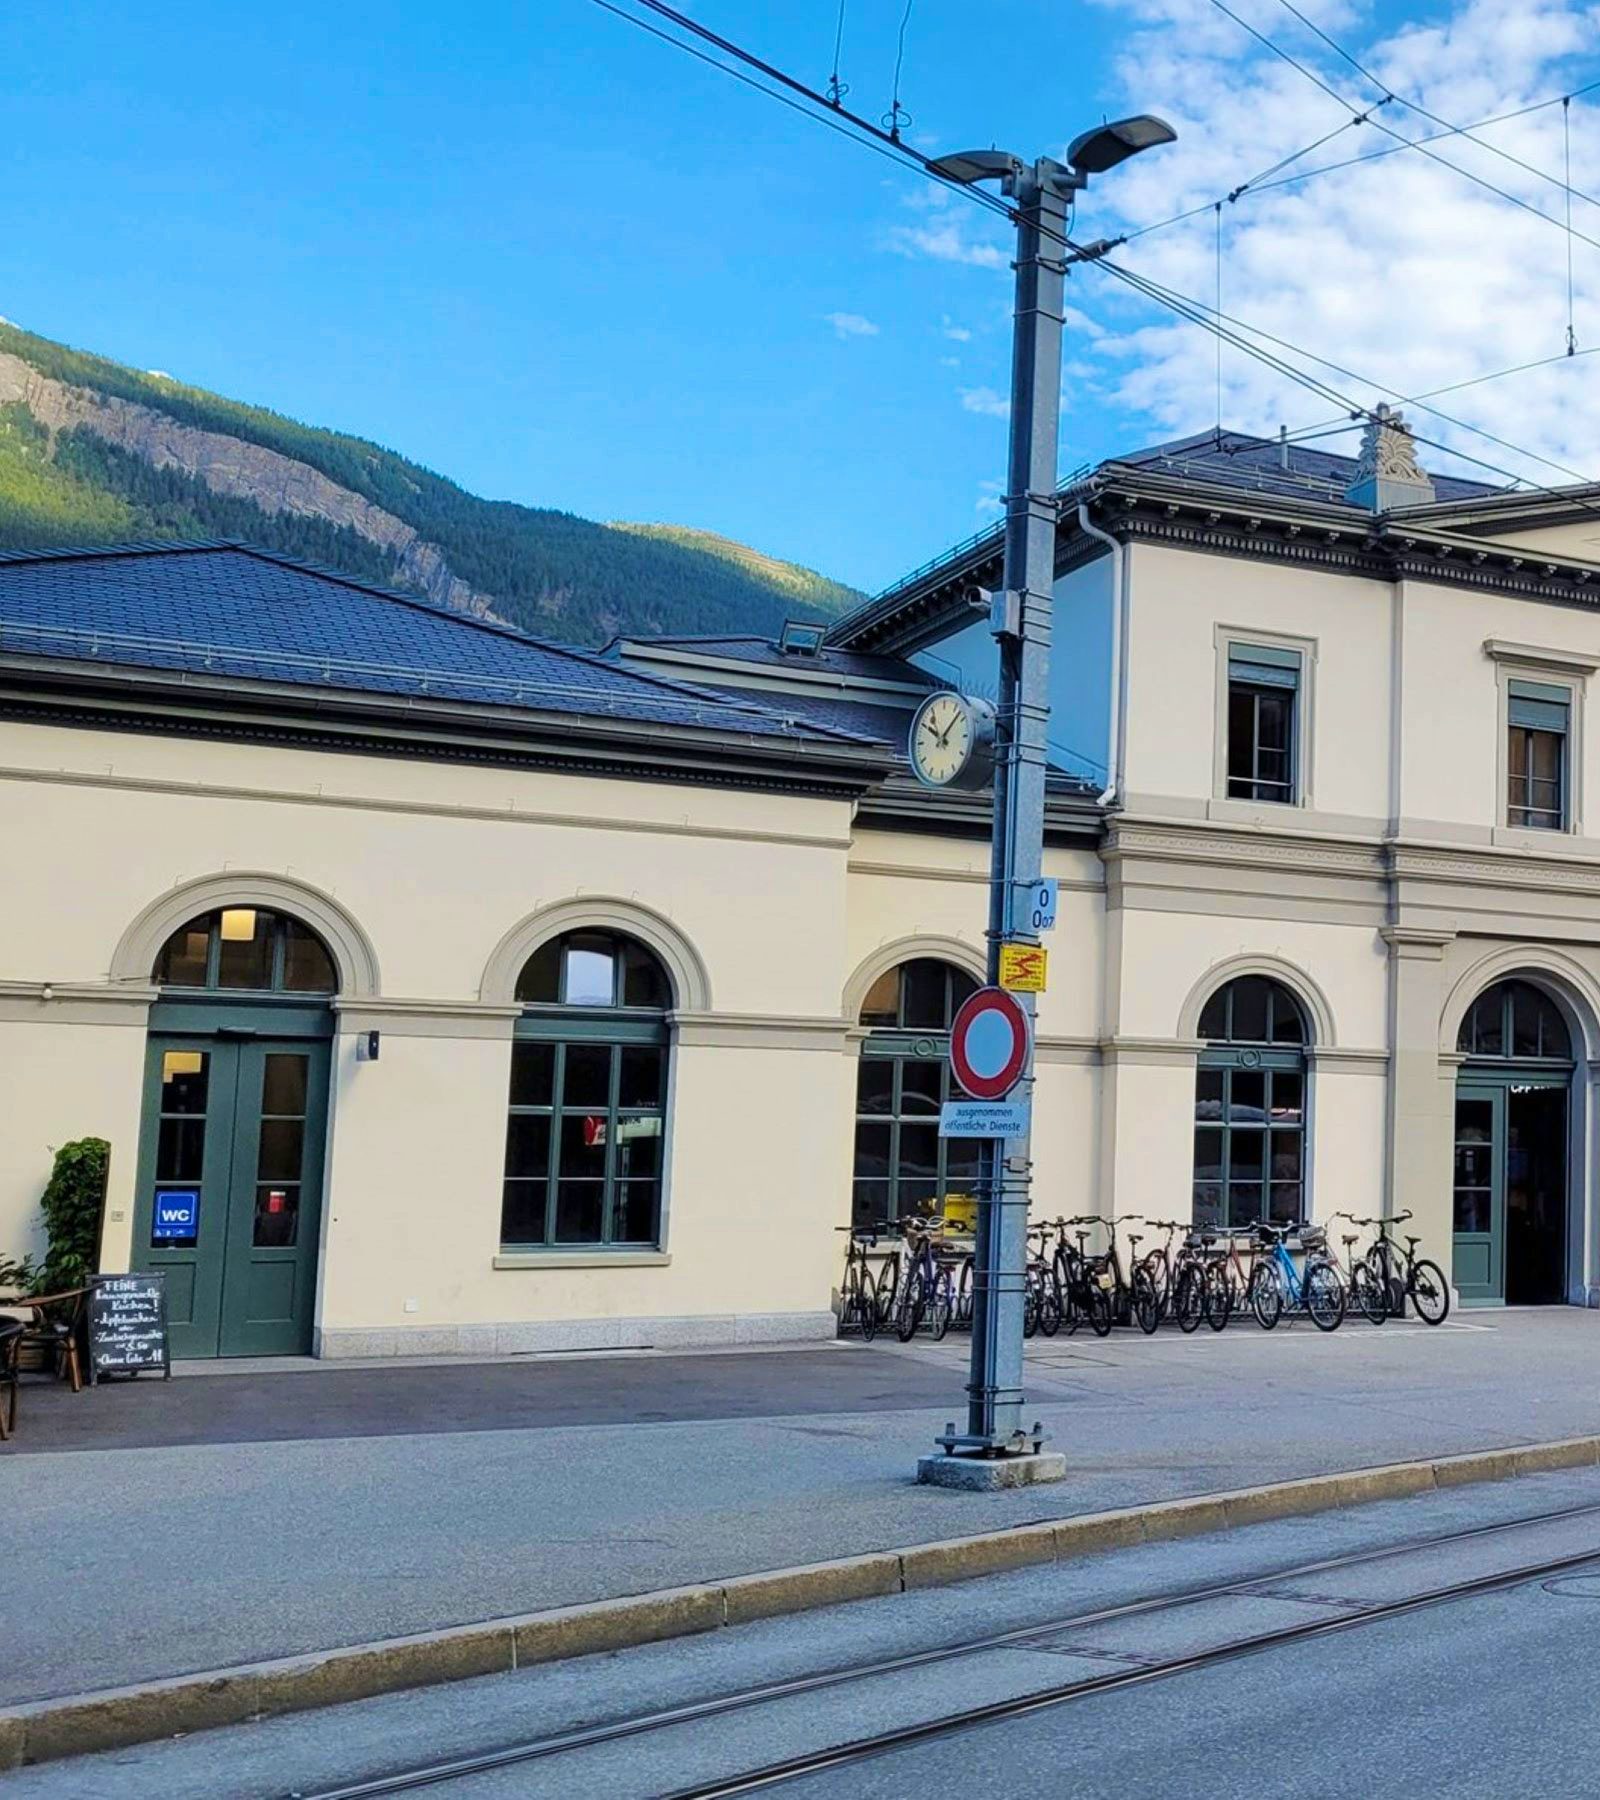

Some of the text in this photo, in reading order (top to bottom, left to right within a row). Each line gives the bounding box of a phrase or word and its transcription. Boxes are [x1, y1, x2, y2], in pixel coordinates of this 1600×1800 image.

[1040, 889, 1049, 907] 0
[956, 1108, 1013, 1119] ausgenommen
[989, 1121, 1021, 1131] Dienste
[162, 1209, 190, 1222] WC
